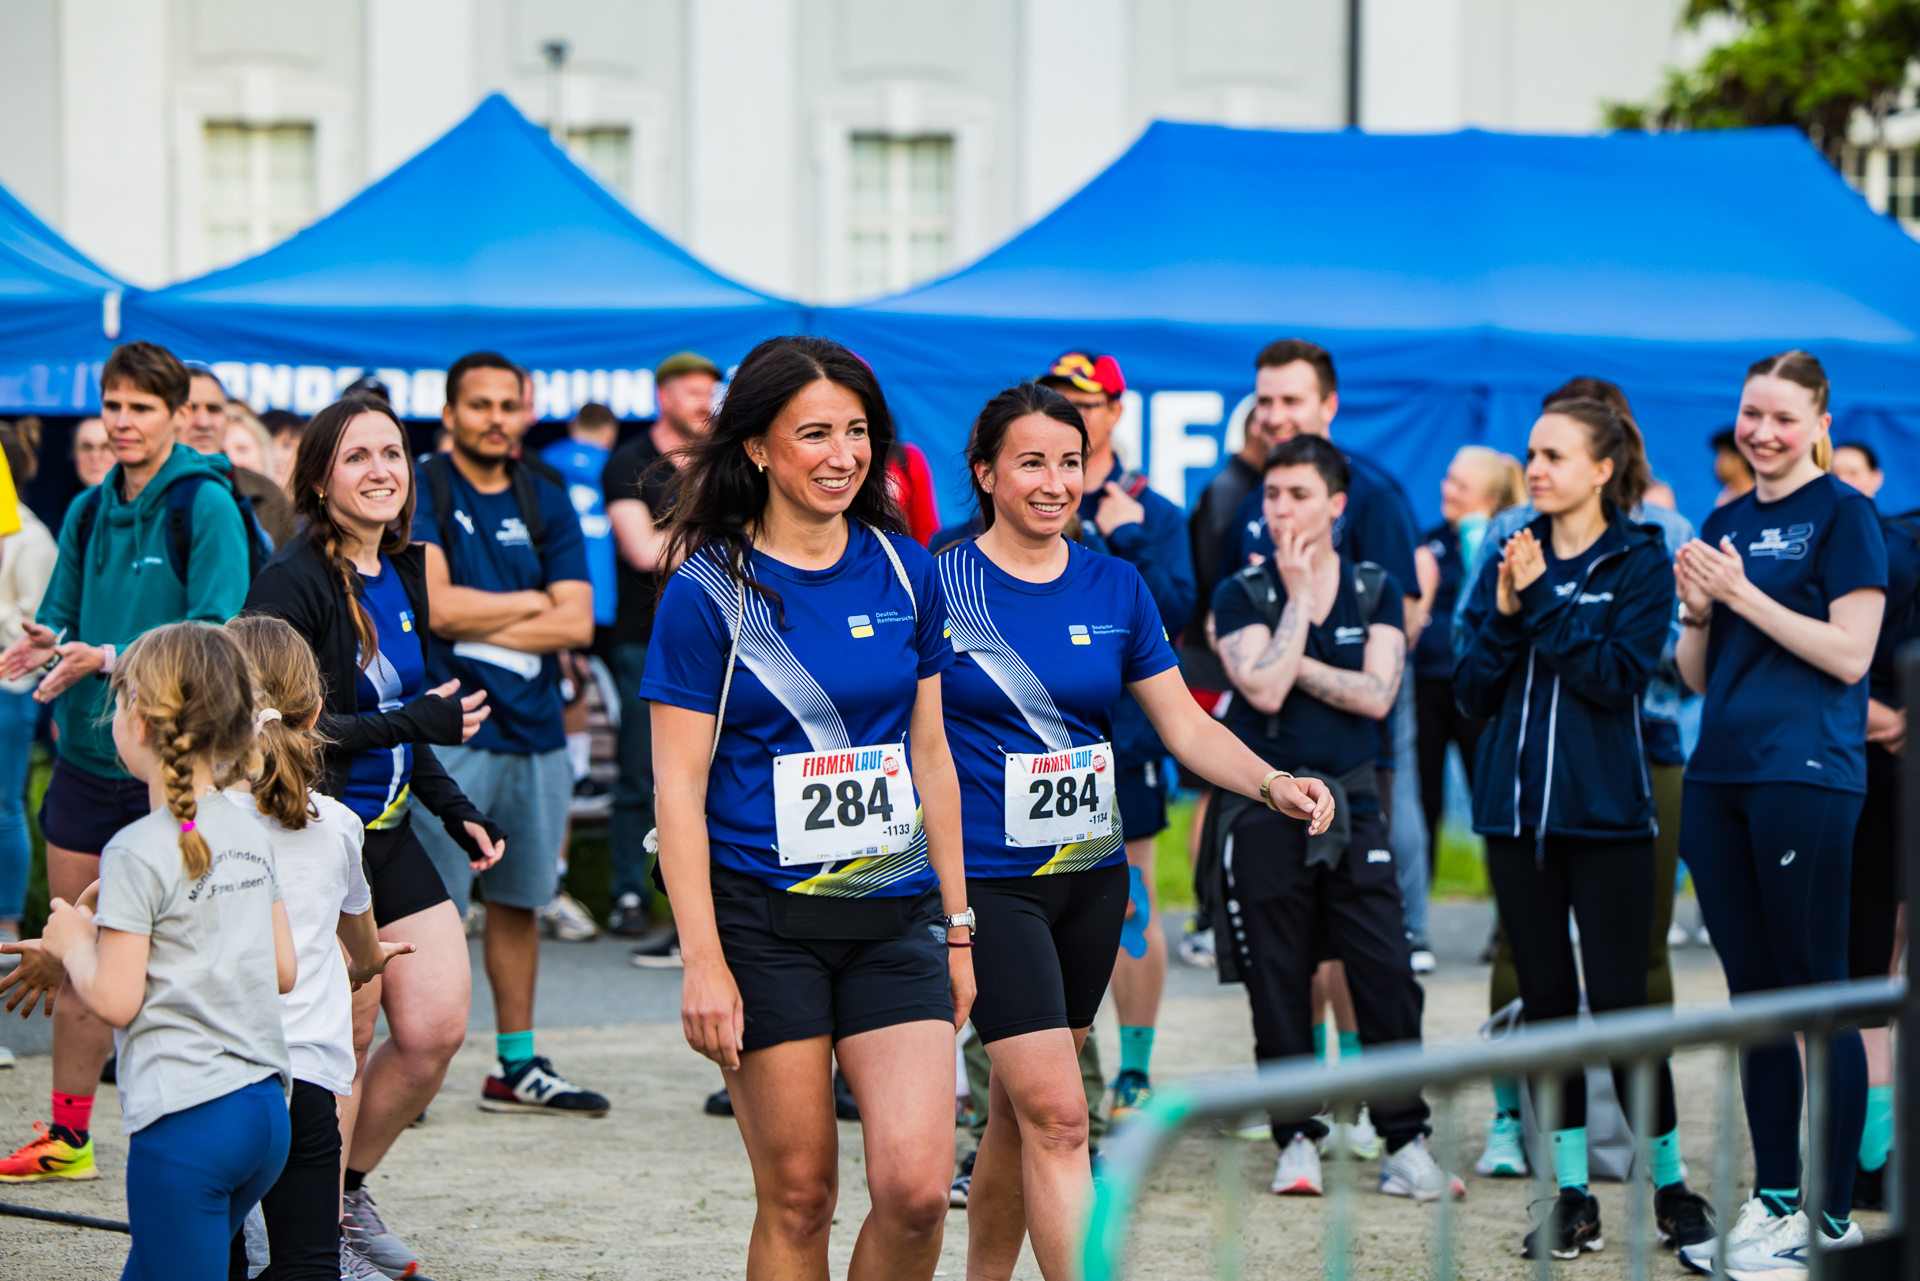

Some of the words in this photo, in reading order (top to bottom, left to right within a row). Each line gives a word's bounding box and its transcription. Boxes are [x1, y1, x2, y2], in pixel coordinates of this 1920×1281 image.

[875, 610, 899, 619] Deutsche
[802, 750, 883, 778] FIRMENLAUF
[1031, 749, 1093, 775] FIRMENLAUF
[802, 776, 894, 831] 284
[1029, 772, 1100, 821] 284
[882, 823, 911, 837] -1133
[1089, 812, 1108, 825] -1134
